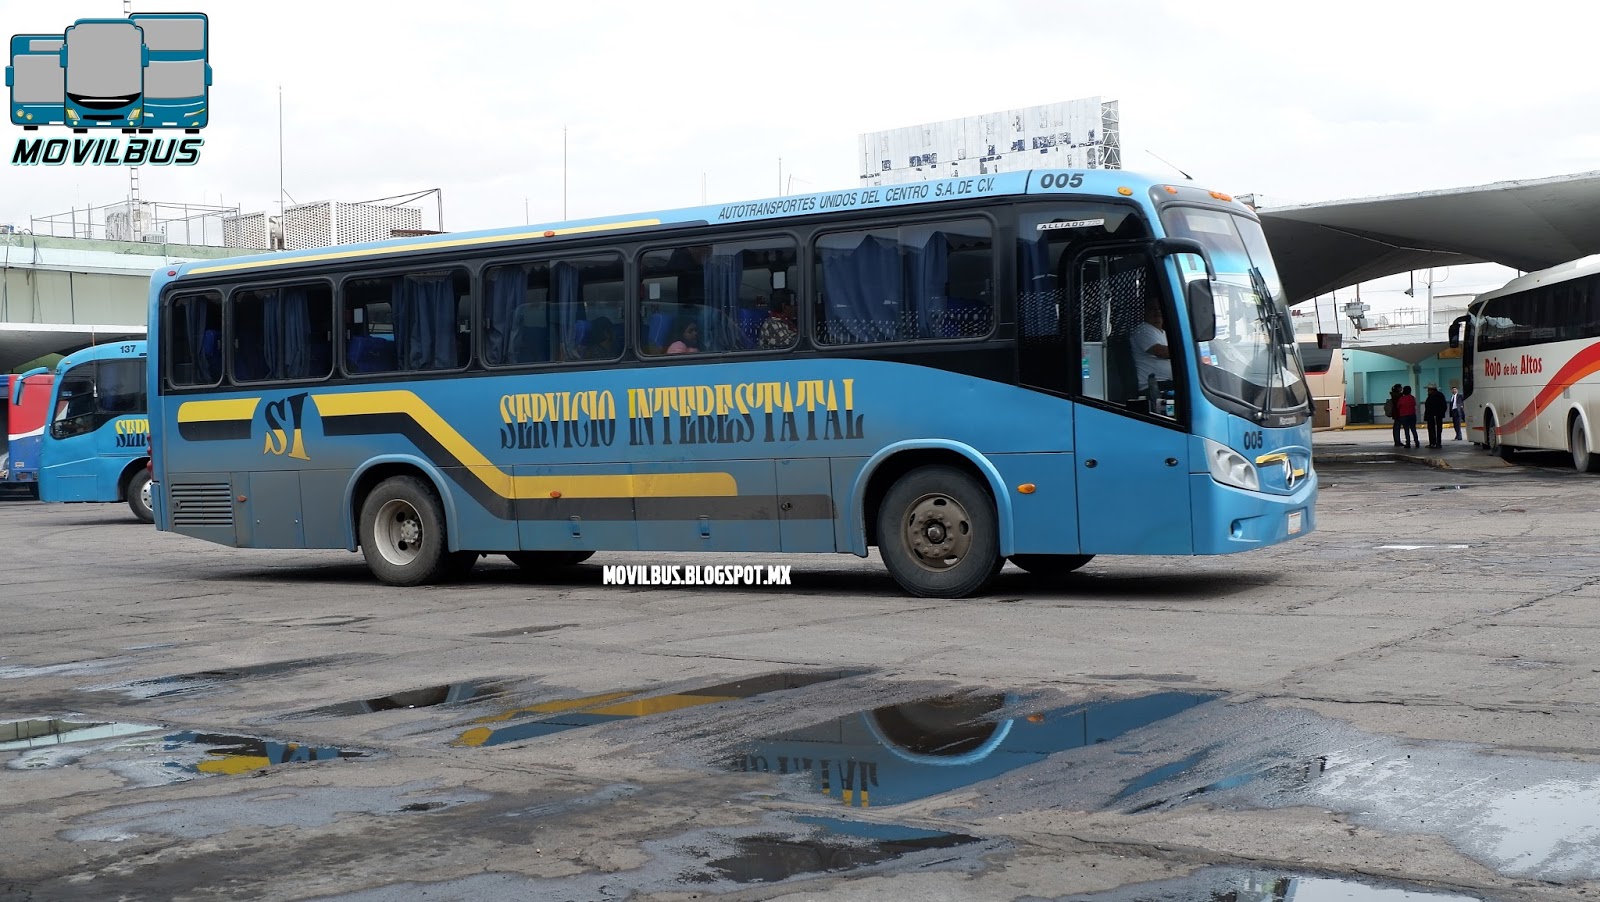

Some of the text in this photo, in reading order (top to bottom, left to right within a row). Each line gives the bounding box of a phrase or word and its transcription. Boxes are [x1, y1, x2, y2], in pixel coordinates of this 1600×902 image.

[1040, 173, 1085, 188] 005
[718, 177, 995, 220] AUTOTRANSPORTES UNIDOS DEL CENTRO S.A. DE C.V.
[1041, 222, 1085, 230] ALLIADO
[120, 345, 136, 353] 137
[1484, 354, 1543, 380] Rojo de los Altos
[499, 378, 864, 450] SERVICIO INTERESTATAL
[263, 392, 311, 461] SI
[1243, 431, 1263, 450] 005
